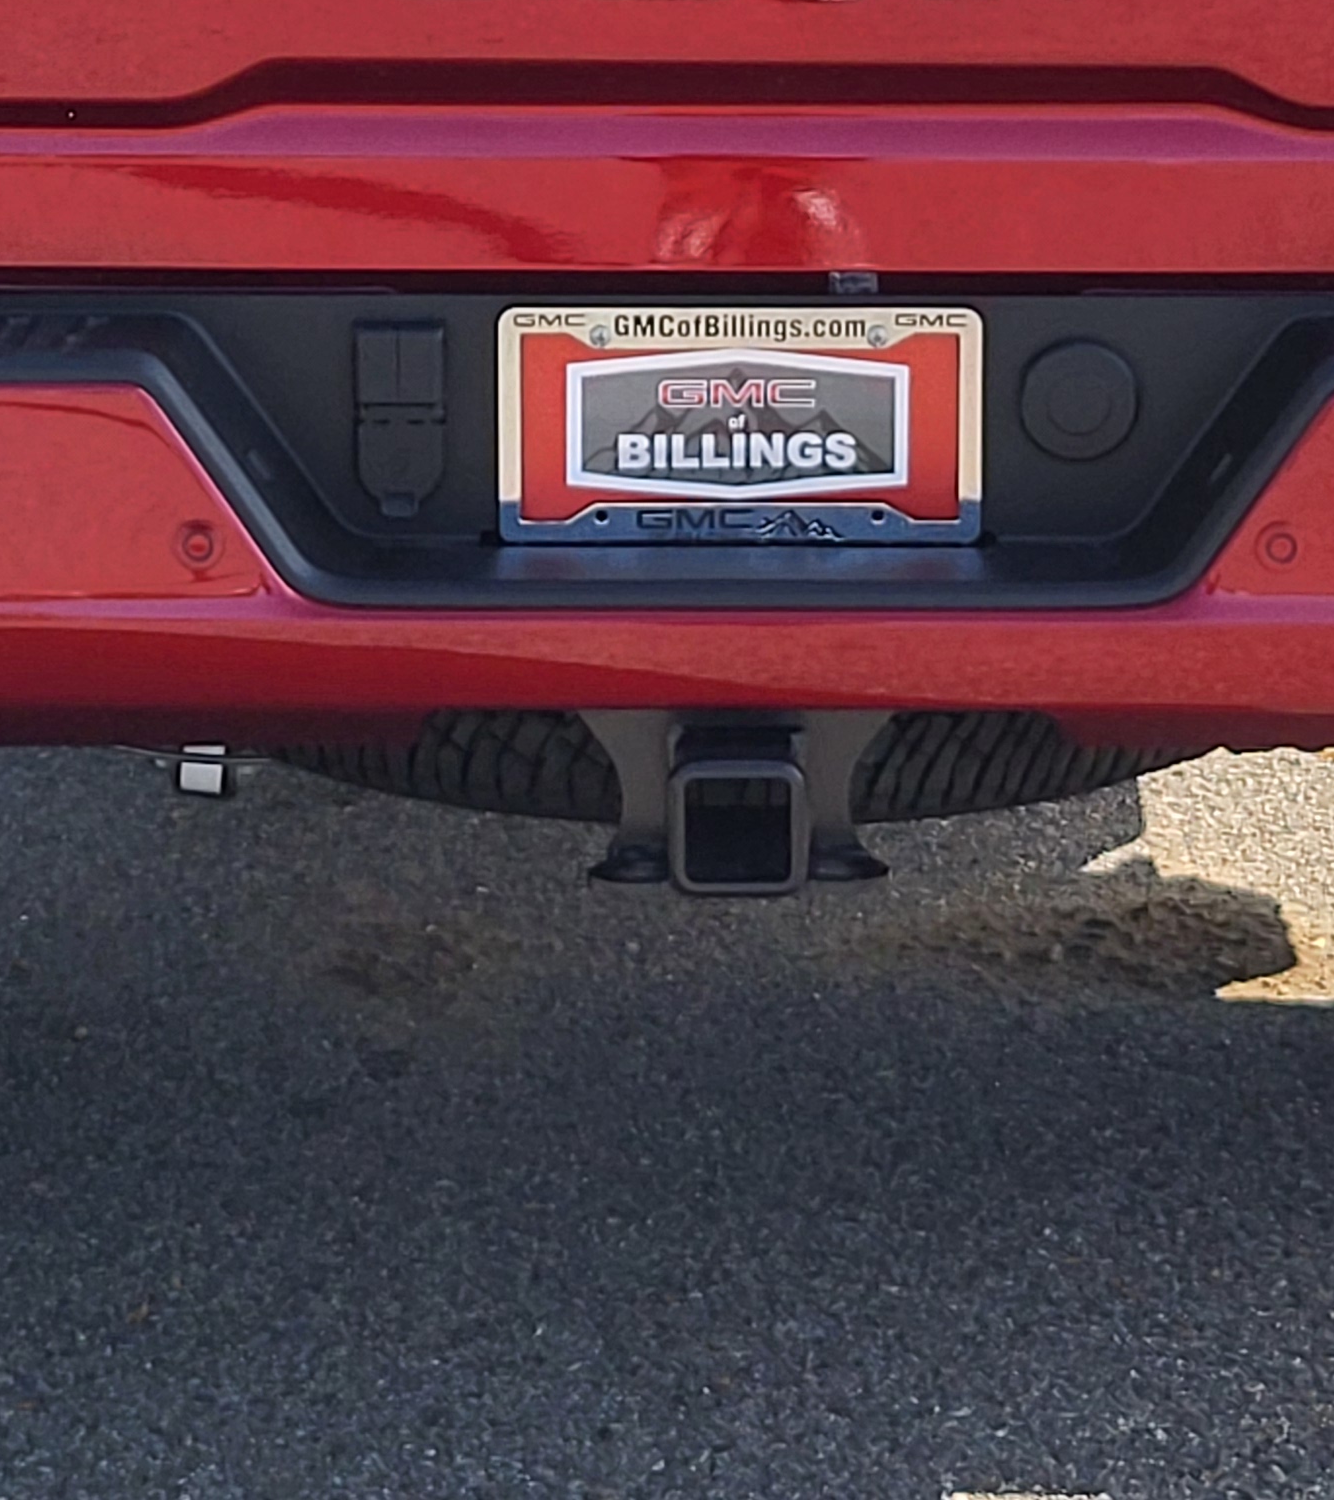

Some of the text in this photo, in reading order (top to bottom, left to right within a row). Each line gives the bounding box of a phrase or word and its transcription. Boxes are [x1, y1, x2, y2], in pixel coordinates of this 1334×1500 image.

[512, 313, 587, 328] GMC
[613, 315, 868, 342] GMCofBillings.com
[894, 313, 968, 328] GMC
[657, 378, 817, 409] GMC
[727, 414, 746, 430] of
[616, 431, 858, 471] BILLINGS
[635, 509, 755, 531] GMC
